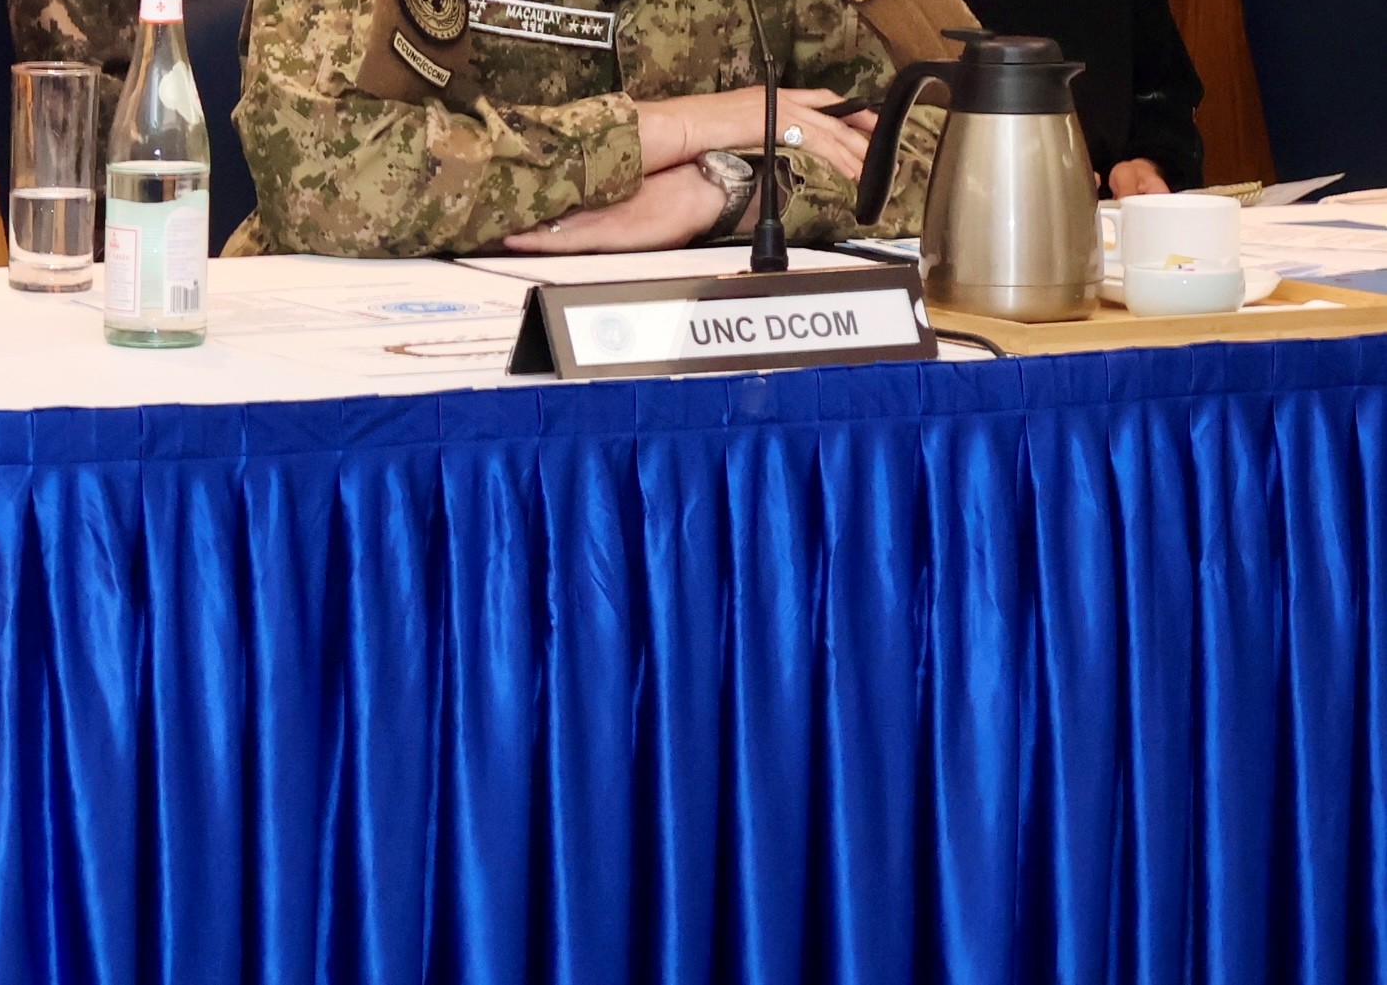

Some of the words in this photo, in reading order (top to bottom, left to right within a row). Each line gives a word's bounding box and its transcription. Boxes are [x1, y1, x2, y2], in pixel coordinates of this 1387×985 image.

[506, 5, 561, 25] MACAULAY
[690, 317, 756, 345] UNC
[765, 310, 859, 341] DCOM
